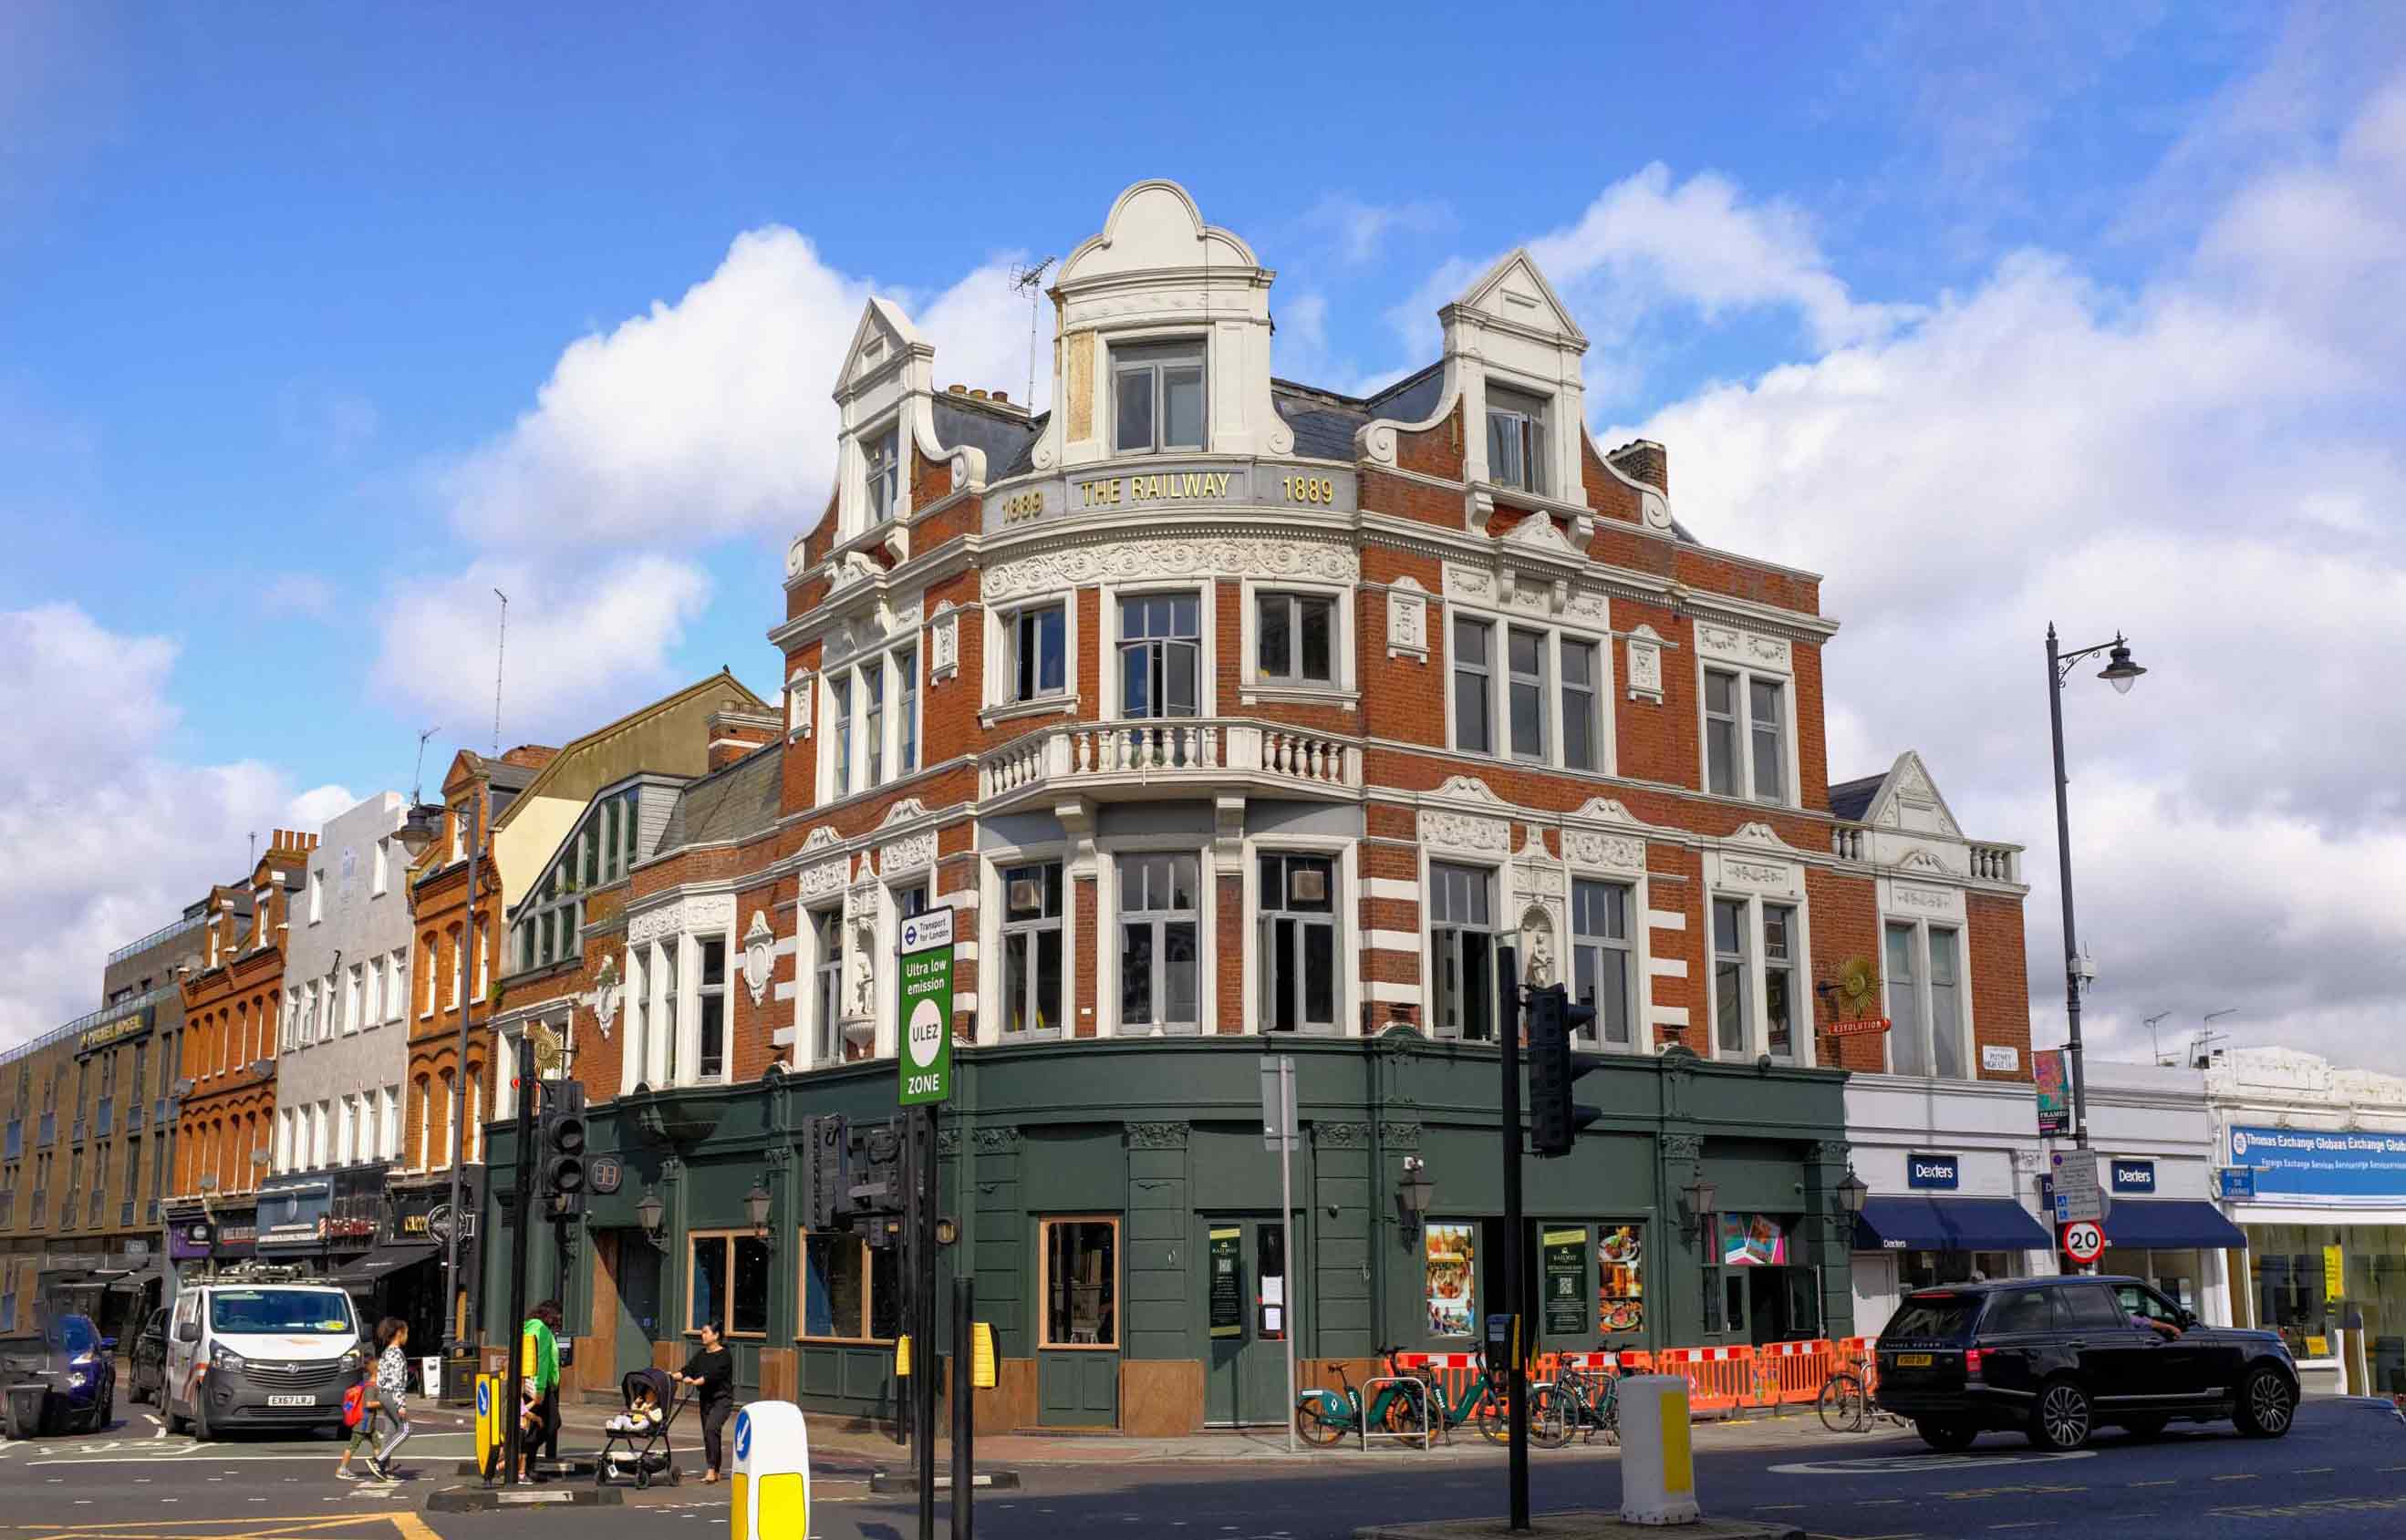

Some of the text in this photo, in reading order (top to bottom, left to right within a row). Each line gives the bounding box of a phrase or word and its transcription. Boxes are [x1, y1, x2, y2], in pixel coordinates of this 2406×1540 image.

[1082, 473, 1230, 506] THE RAILWAY
[1283, 476, 1333, 504] 1889
[1003, 491, 1043, 524] 1889
[919, 918, 946, 931] Transport
[919, 930, 949, 942] for London
[907, 959, 947, 977] Ultra low
[907, 977, 945, 996] emission
[912, 1024, 939, 1043] ULEZ
[908, 1073, 939, 1095] ZONE
[2245, 1132, 2276, 1146] Thomas
[2277, 1134, 2315, 1152] Exchange
[2349, 1136, 2385, 1153] Exchange
[1915, 1163, 1953, 1179] Dexters
[2118, 1169, 2151, 1183] Dexters
[1882, 1239, 1906, 1248] Dexters
[2069, 1231, 2099, 1249] 20
